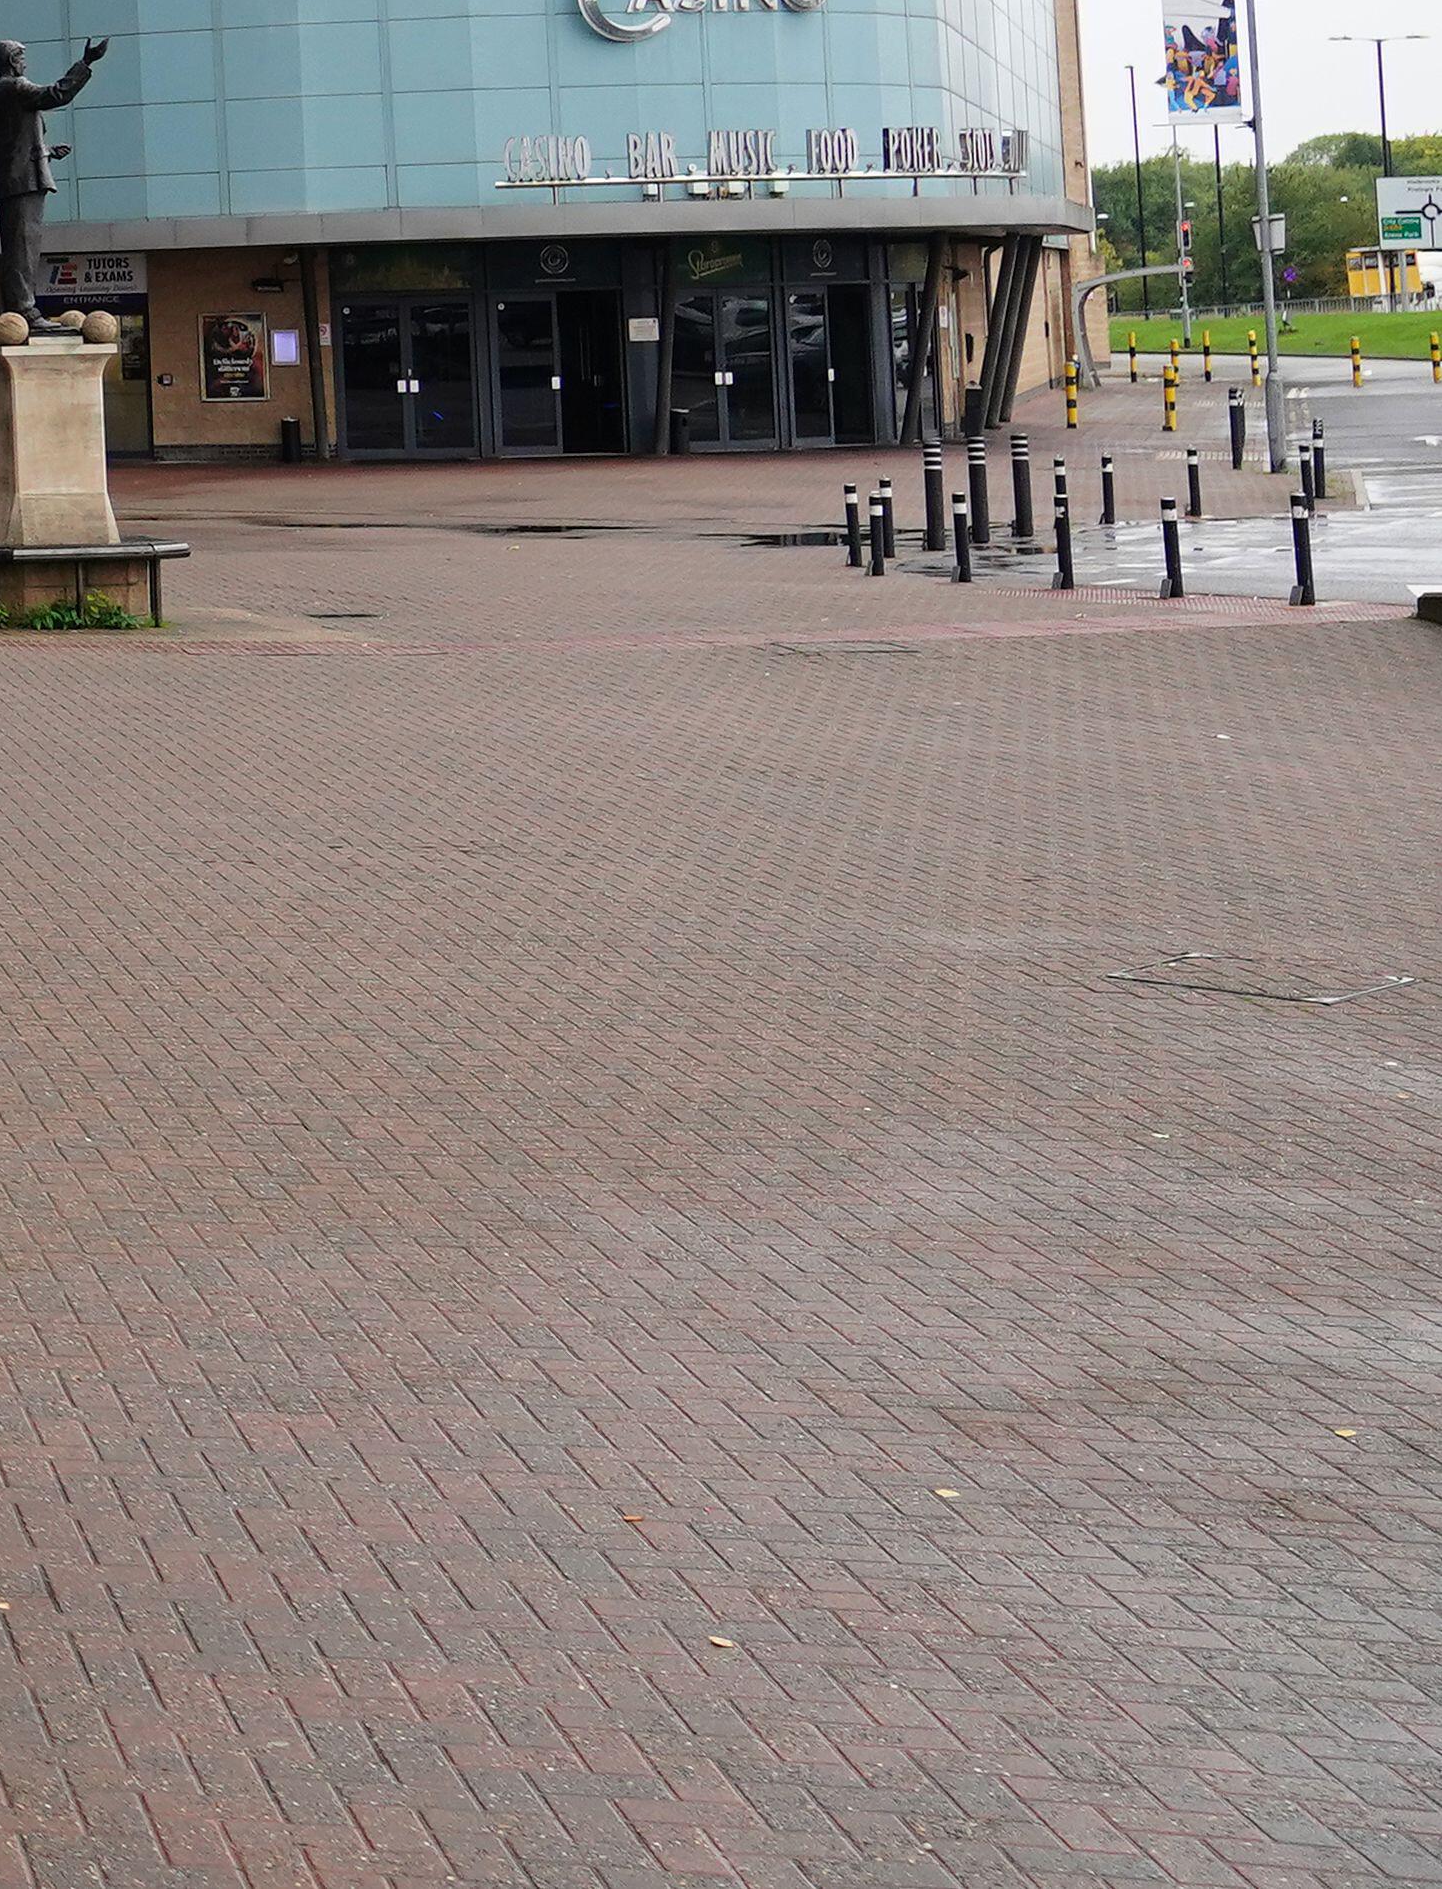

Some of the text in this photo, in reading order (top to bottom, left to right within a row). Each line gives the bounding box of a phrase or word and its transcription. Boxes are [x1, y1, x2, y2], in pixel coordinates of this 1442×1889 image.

[504, 134, 592, 182] CASINO
[627, 131, 679, 178] BAR
[708, 129, 777, 176] MUSIC
[806, 127, 859, 174] FOOD
[882, 127, 942, 172] POKER
[87, 257, 130, 270] TUTORS
[84, 271, 134, 283] & EXAMS
[63, 296, 120, 304] ENTRANCE
